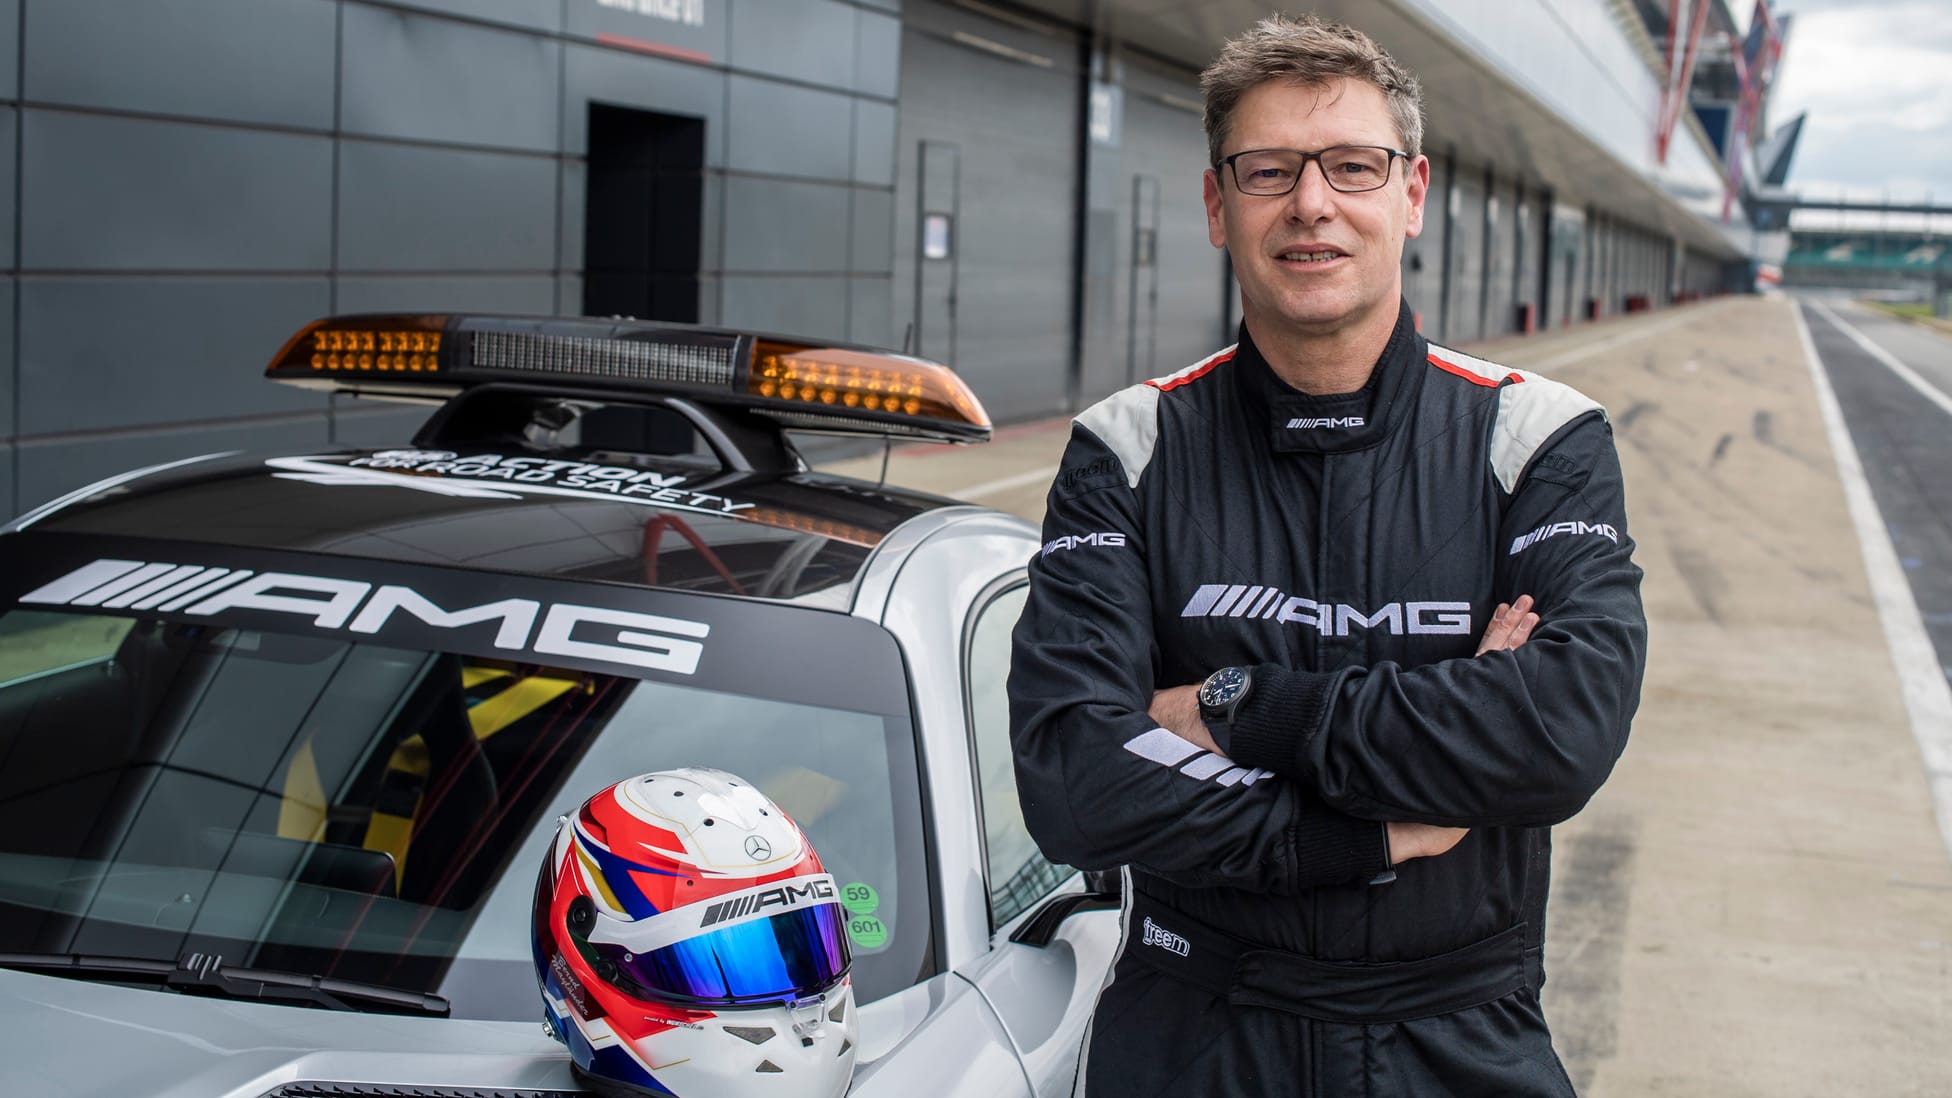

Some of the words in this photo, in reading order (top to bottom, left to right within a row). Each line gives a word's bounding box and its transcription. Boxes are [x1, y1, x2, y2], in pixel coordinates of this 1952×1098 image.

[1312, 416, 1365, 429] AMG
[348, 458, 419, 469] FOR
[416, 461, 555, 482] ROAD
[557, 474, 756, 512] SAFETY
[452, 453, 688, 488] ACTION
[1050, 532, 1126, 553] AMG
[1546, 520, 1618, 545] AMG
[184, 571, 711, 675] AMG
[1276, 595, 1471, 637] AMG
[751, 879, 834, 914] AMG
[846, 886, 870, 901] 59
[851, 920, 881, 934] 601
[1143, 916, 1190, 957] freem
